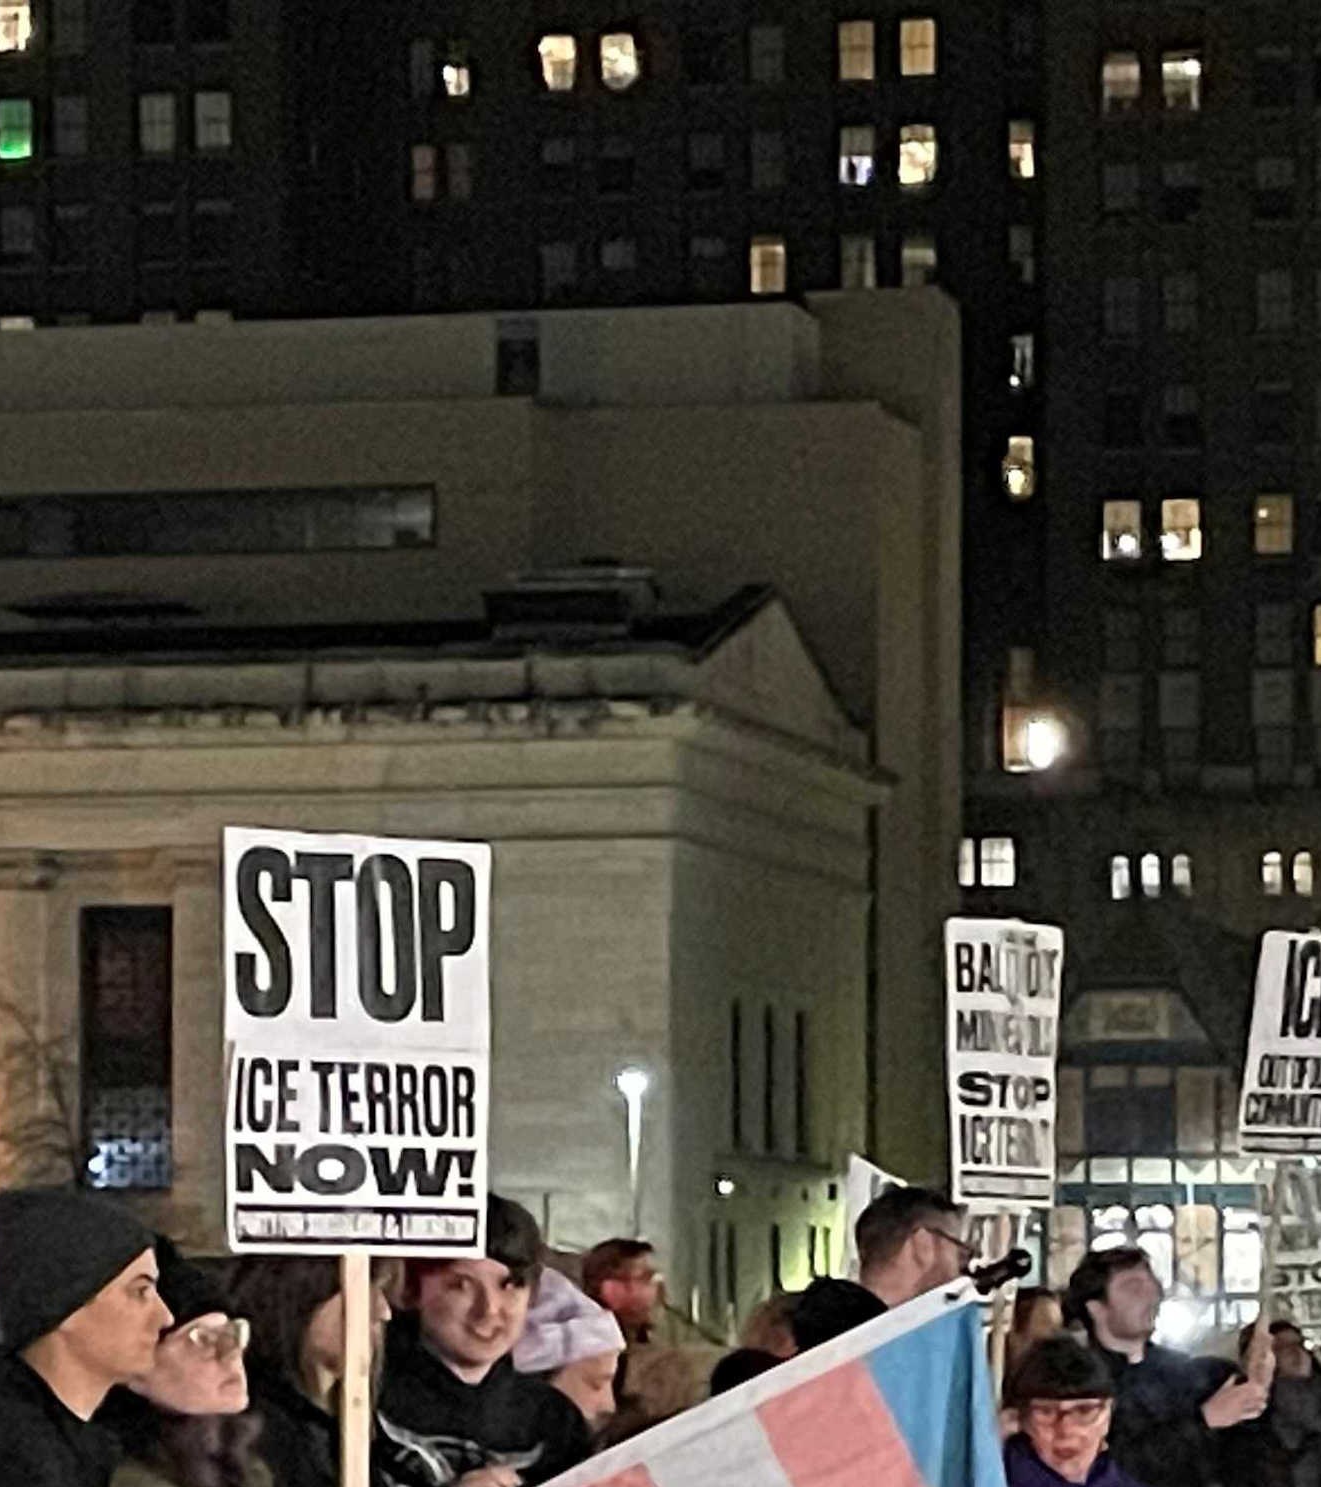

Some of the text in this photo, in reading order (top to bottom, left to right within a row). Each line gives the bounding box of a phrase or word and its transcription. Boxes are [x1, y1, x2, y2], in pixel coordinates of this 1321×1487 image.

[234, 845, 476, 1022] STOP
[233, 1056, 476, 1139] ICE TERROR
[957, 1071, 1051, 1110] STOP
[235, 1143, 477, 1197] NOW!
